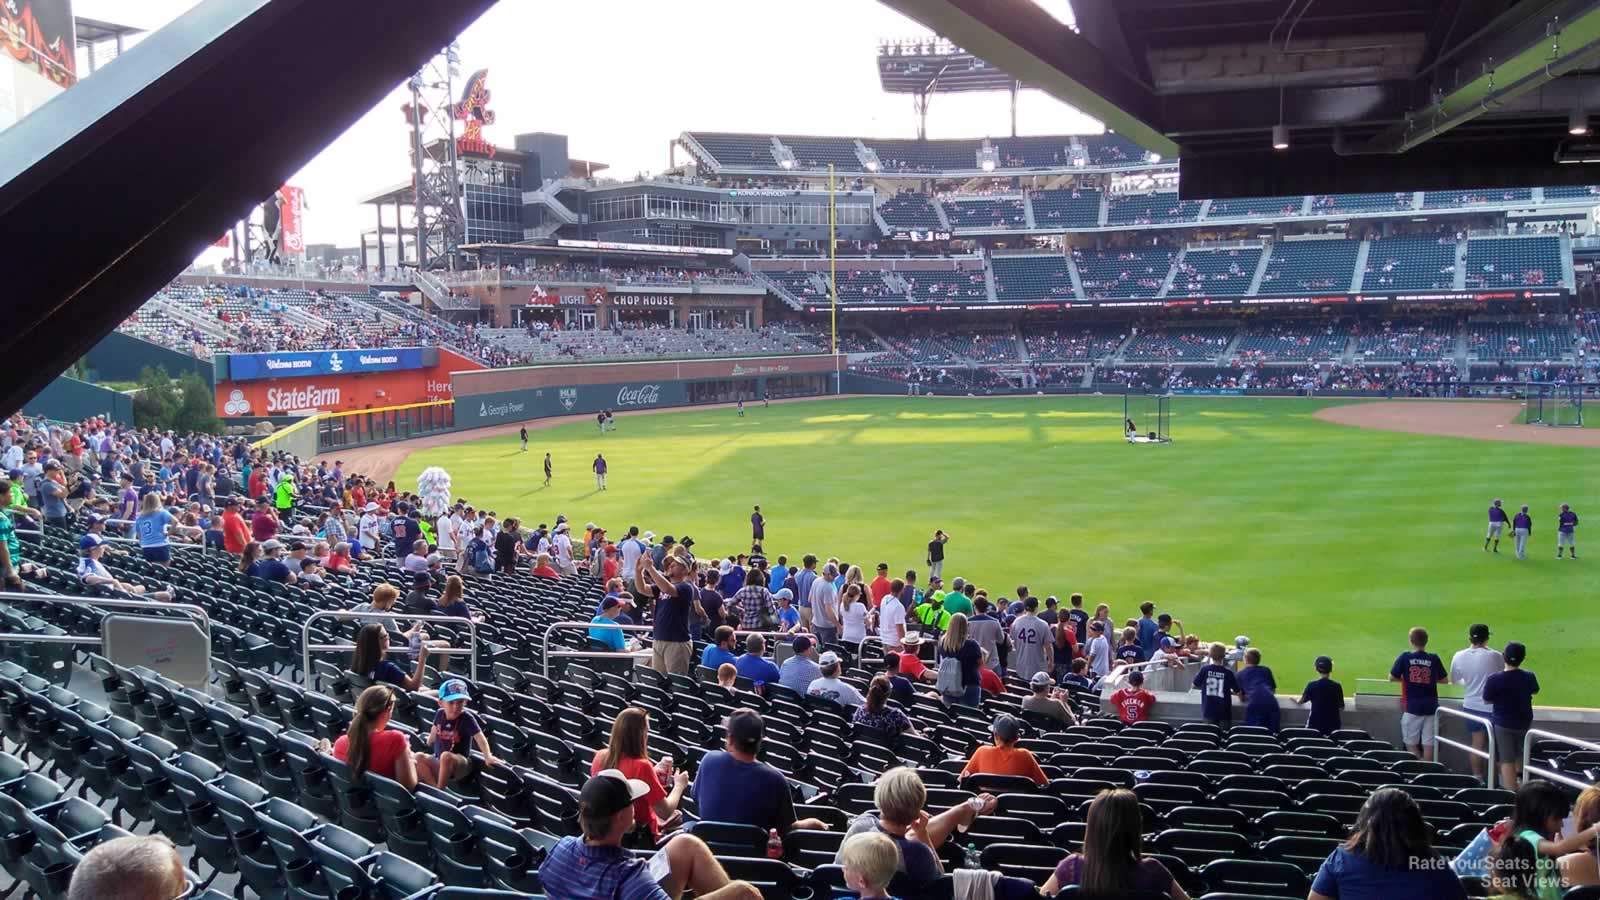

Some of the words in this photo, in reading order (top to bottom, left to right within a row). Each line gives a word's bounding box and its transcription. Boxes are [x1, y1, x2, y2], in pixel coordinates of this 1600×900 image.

[560, 295, 585, 304] LIGHT
[613, 295, 640, 305] CHOP
[643, 295, 674, 305] HOUSE
[267, 385, 340, 411] StateFarm
[488, 404, 509, 416] Georgia
[143, 520, 152, 535] 3
[1018, 628, 1036, 643] 42
[1206, 677, 1225, 698] 21
[1127, 705, 1138, 720] 5
